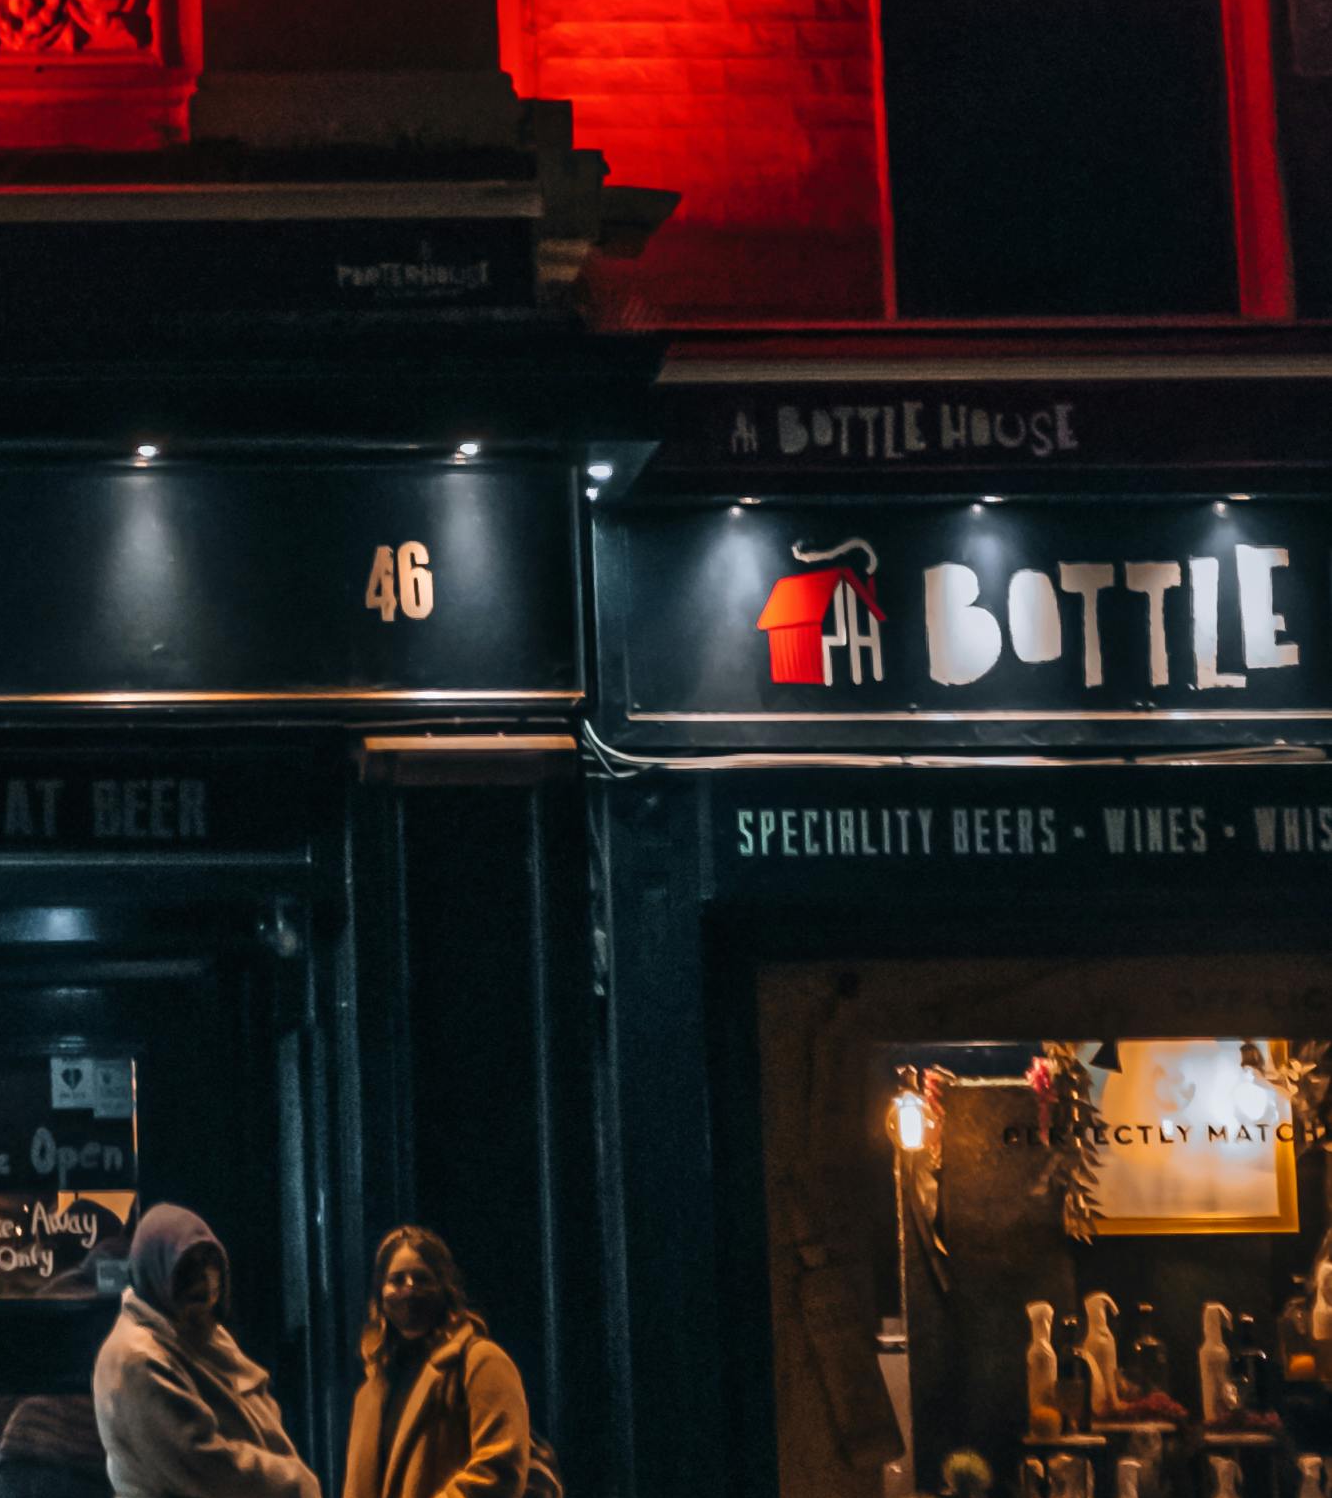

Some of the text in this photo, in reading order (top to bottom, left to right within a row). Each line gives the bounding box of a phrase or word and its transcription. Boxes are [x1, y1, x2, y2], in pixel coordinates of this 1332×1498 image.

[777, 400, 928, 459] BOTTLE
[939, 400, 1080, 457] HOUSE
[364, 540, 434, 622] 46
[922, 543, 1300, 691] BOTTLE
[89, 777, 209, 839] BEER
[737, 807, 934, 856] SPECIALITY
[952, 807, 1059, 856] BEERS
[1102, 806, 1209, 855] WINES
[29, 1126, 123, 1191] Open
[31, 1200, 99, 1249] Away
